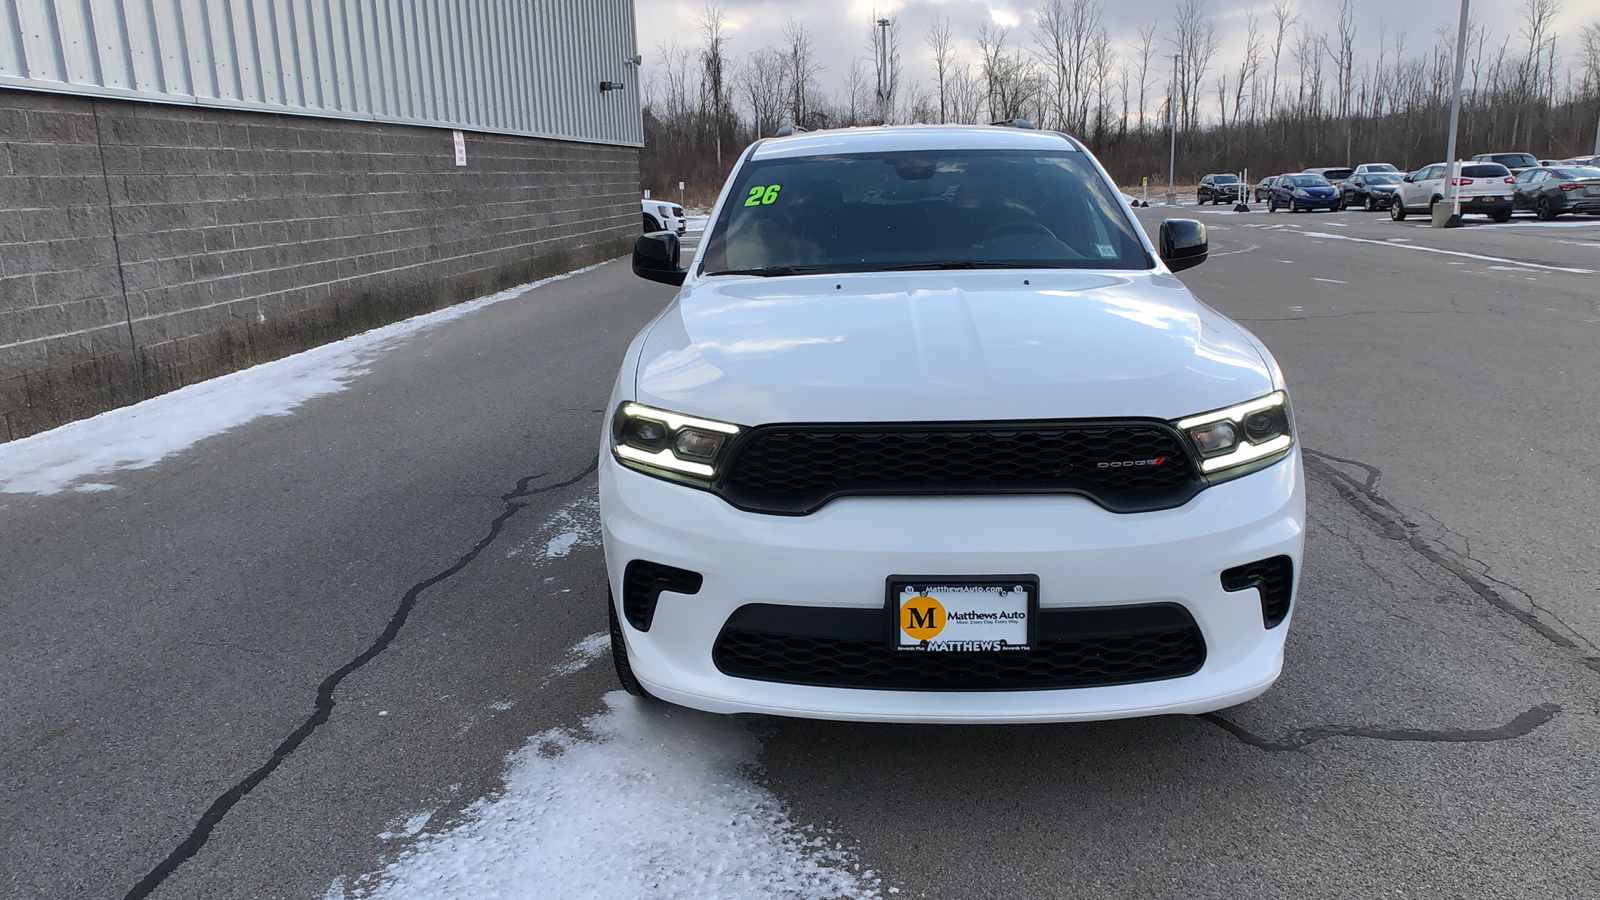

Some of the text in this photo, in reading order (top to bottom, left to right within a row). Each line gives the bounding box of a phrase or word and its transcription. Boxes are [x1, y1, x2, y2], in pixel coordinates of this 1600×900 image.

[744, 184, 781, 207] 26
[1097, 459, 1158, 468] DODGE
[906, 607, 937, 628] M
[947, 610, 1026, 620] Matthews Auto
[927, 641, 1001, 652] MATTHEWS
